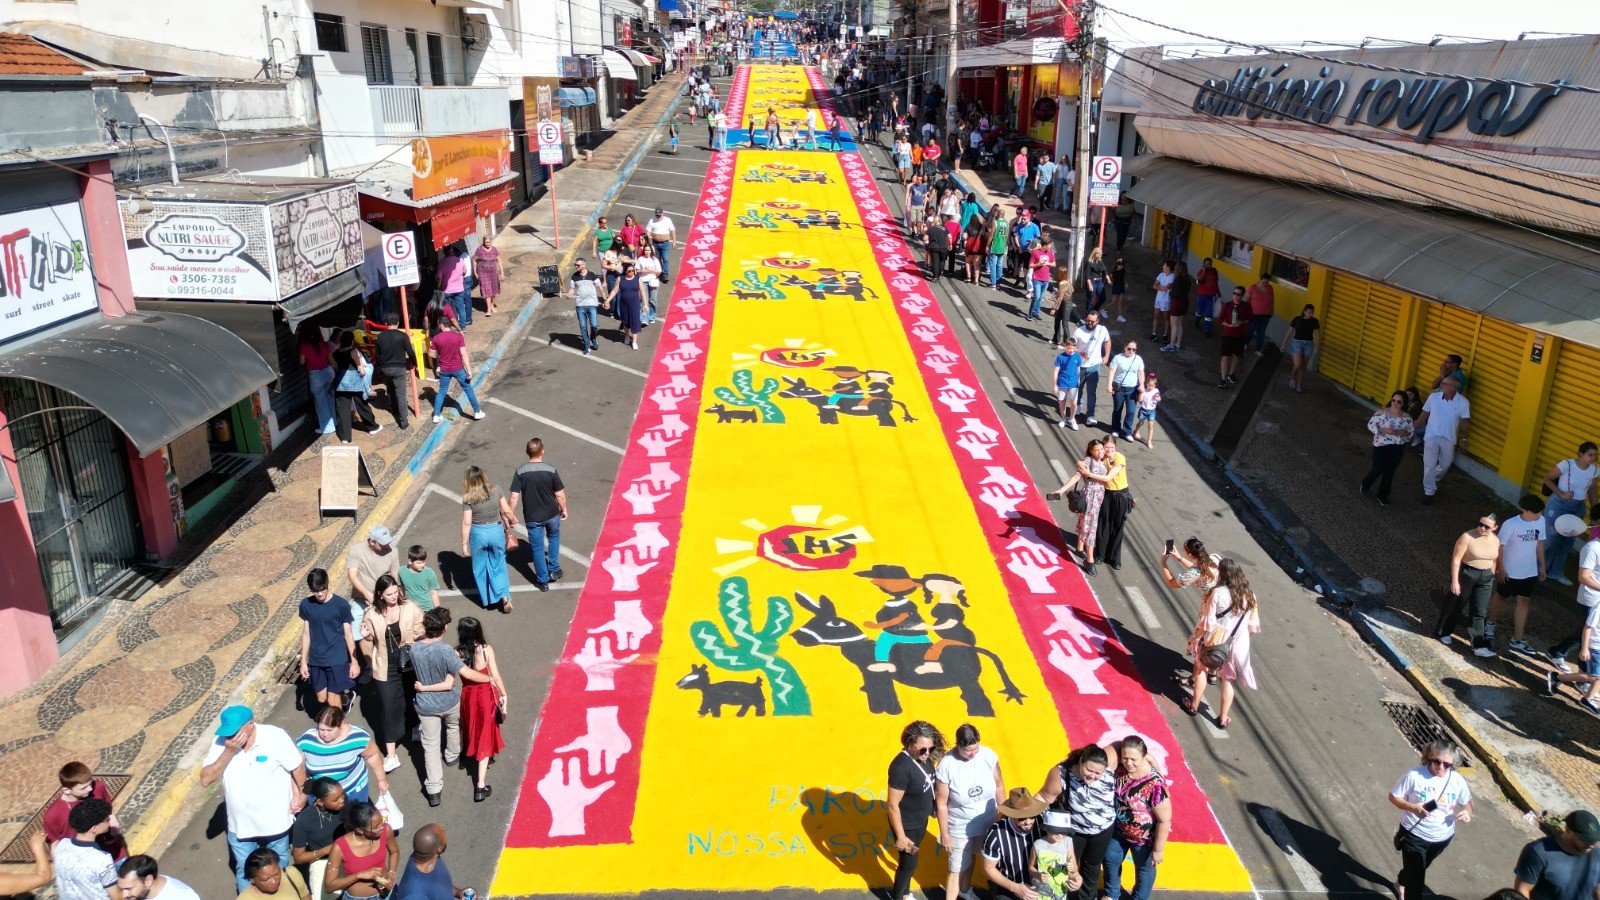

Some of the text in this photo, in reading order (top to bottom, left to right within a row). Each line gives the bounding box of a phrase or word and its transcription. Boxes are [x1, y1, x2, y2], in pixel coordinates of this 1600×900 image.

[1345, 77, 1569, 144] roupas
[546, 128, 553, 140] E
[1102, 162, 1112, 176] E
[158, 232, 191, 244] NUTRI
[394, 240, 404, 254] E
[150, 262, 165, 271] Sua
[166, 263, 188, 272] saúde
[182, 274, 236, 284] 3506-7385
[178, 286, 234, 295] 99316-0044
[5, 292, 81, 320] surf street skate
[781, 533, 858, 555] IHS
[687, 828, 807, 857] NOSSA
